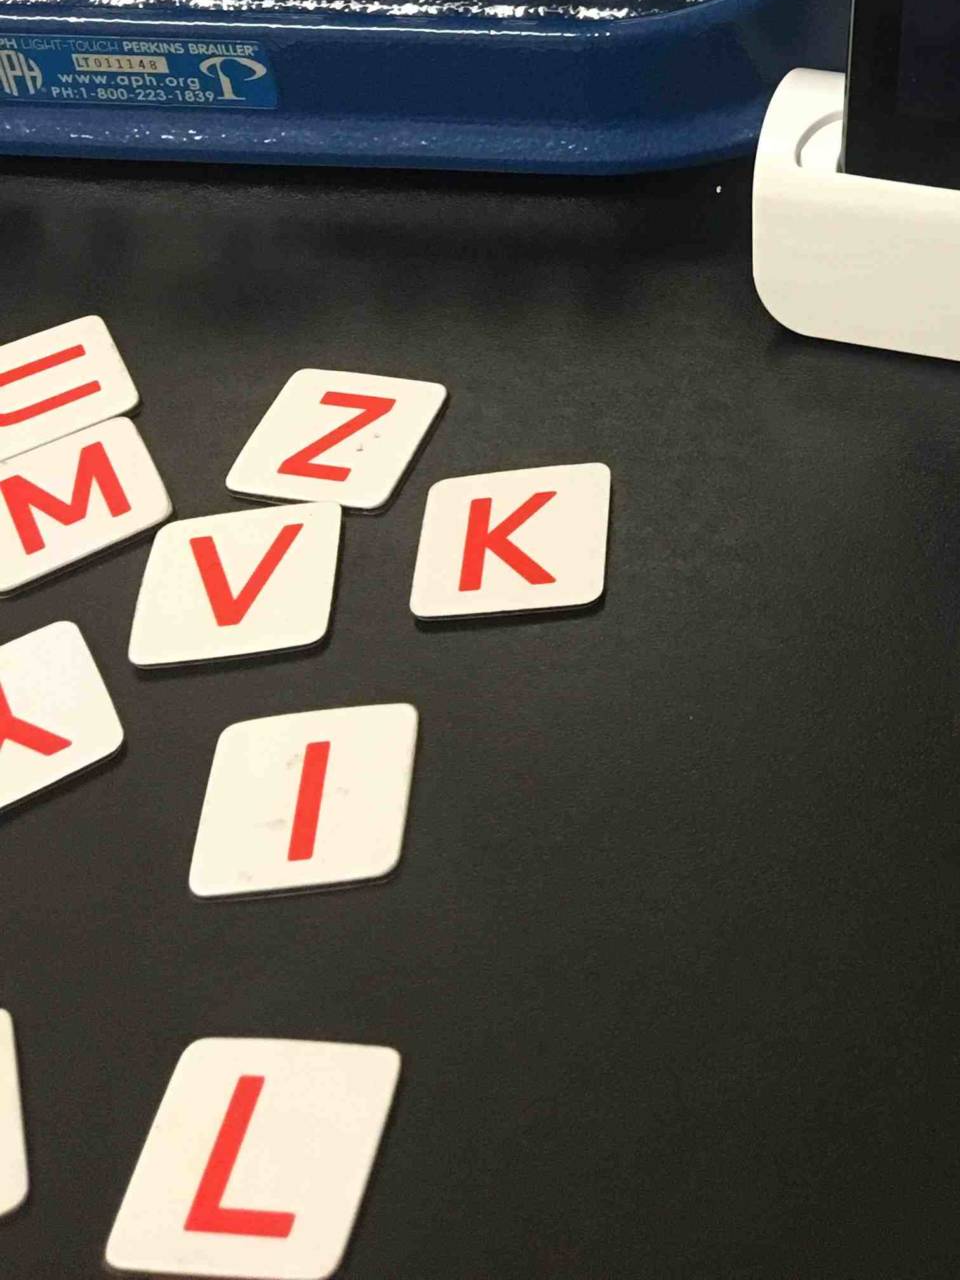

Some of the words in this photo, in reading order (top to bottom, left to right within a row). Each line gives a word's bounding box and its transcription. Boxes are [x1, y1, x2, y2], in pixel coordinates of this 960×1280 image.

[21, 38, 119, 52] LIGHT-TOUCH
[122, 40, 185, 55] PERKINS
[51, 86, 215, 103] PH:1-800-223-1839
[57, 73, 201, 91] www.aph.org
[277, 391, 397, 482] Z
[0, 441, 132, 555] M
[458, 490, 558, 592] K
[189, 522, 304, 627] V
[183, 1074, 296, 1238] L
